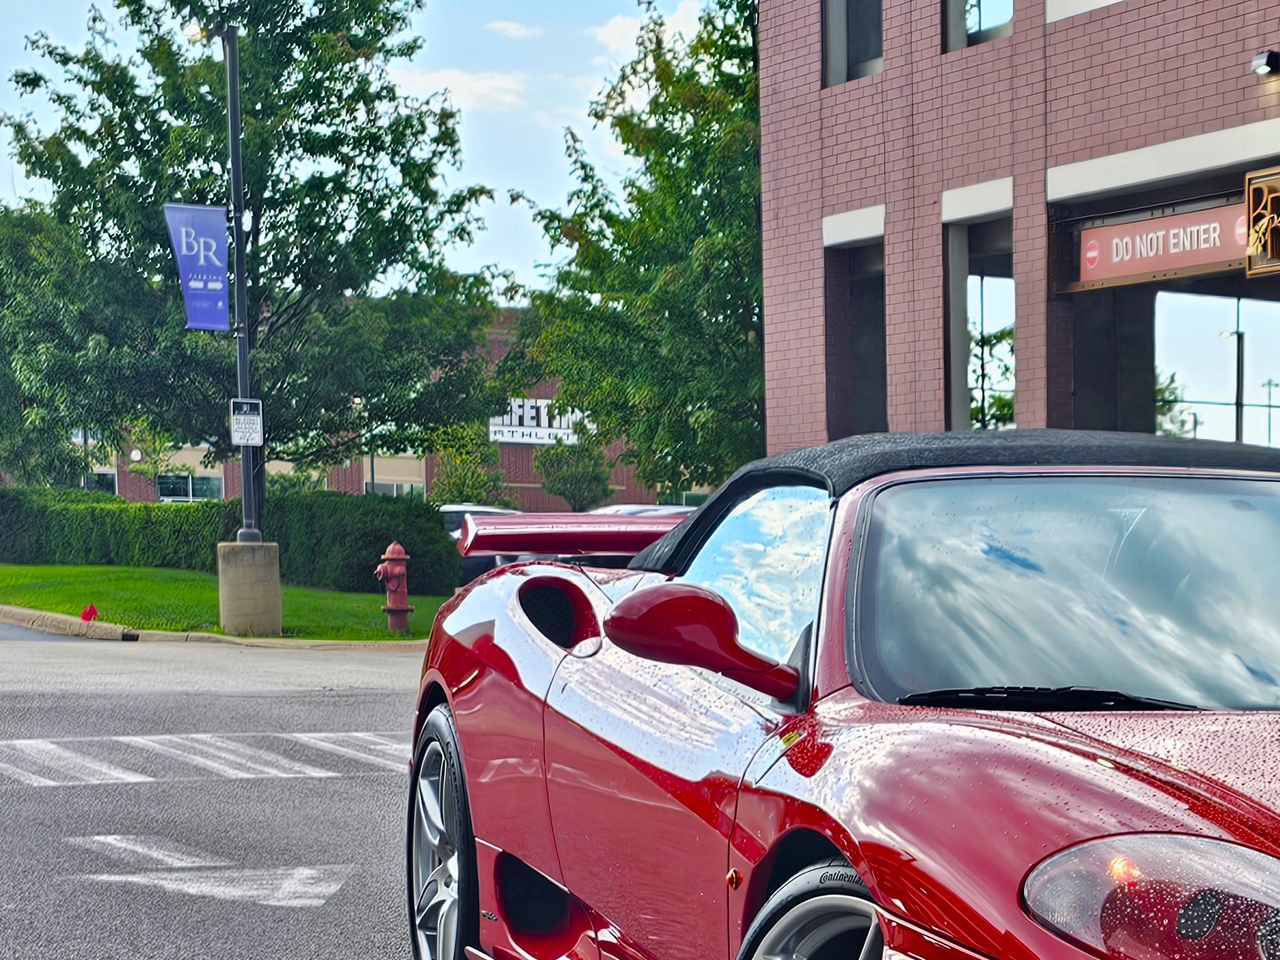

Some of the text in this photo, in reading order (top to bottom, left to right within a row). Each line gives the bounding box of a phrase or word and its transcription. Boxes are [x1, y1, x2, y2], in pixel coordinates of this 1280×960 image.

[180, 226, 224, 267] BR
[1112, 222, 1221, 263] DO NOT ENTER
[819, 870, 863, 886] Continenta
